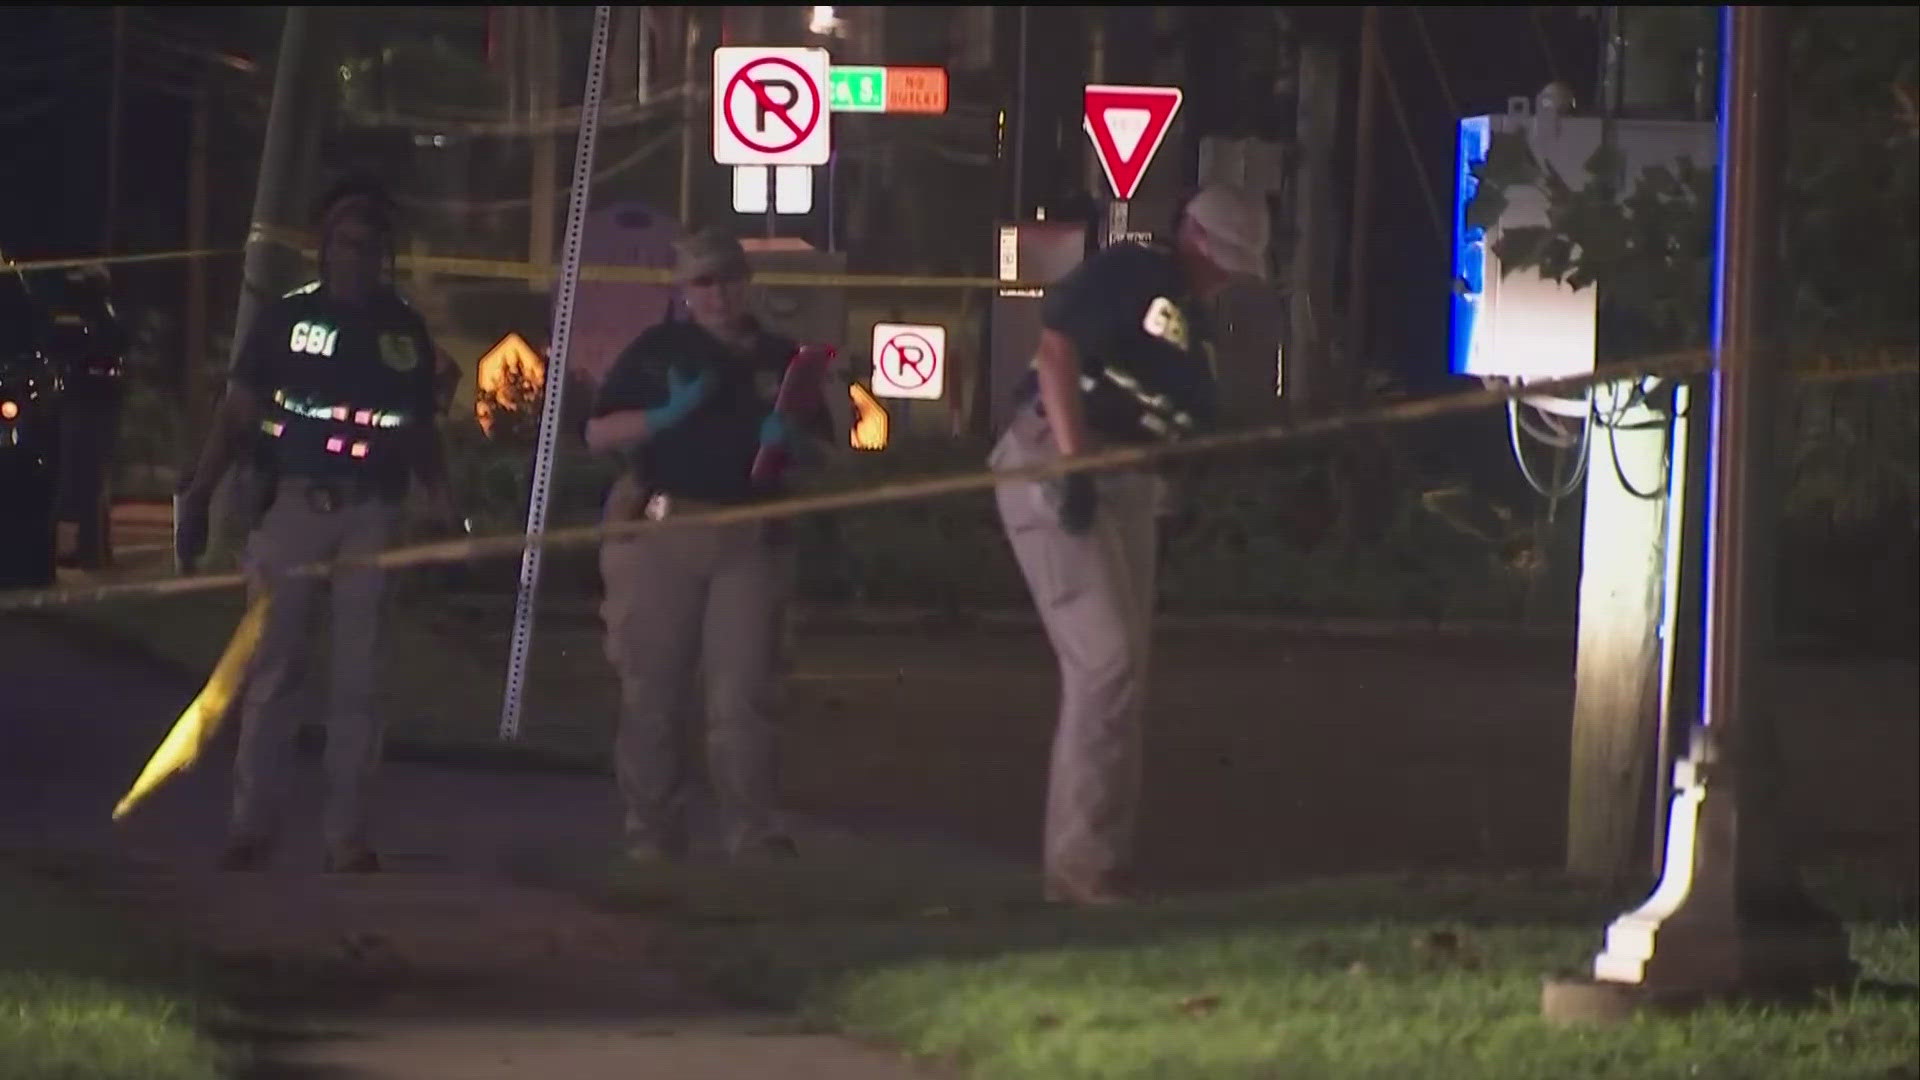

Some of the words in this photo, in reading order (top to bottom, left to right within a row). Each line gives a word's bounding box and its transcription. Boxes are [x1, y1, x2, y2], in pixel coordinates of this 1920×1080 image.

[904, 76, 925, 90] NO
[754, 80, 798, 132] P
[290, 321, 338, 357] GBI
